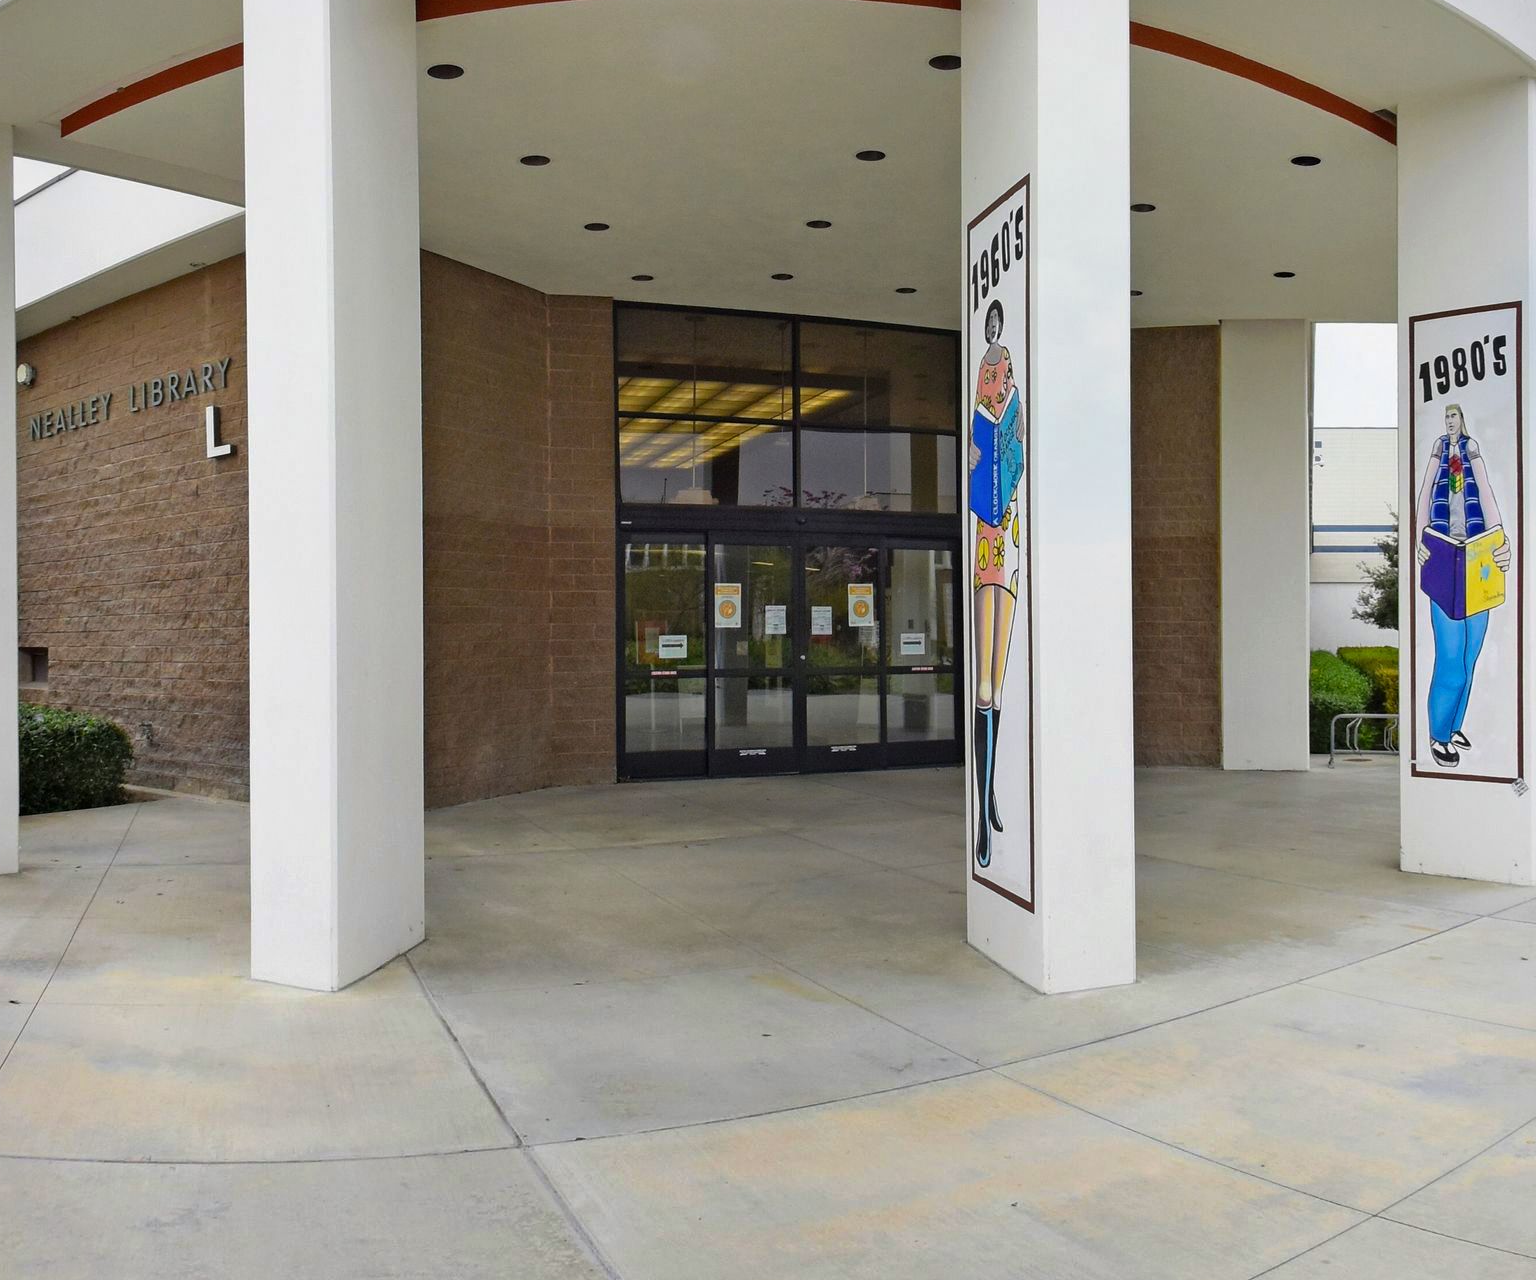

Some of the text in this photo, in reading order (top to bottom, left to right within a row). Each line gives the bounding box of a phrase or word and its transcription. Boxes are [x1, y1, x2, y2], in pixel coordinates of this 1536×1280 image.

[30, 357, 232, 441] NEALLEY LIBRARY
[205, 404, 234, 458] L
